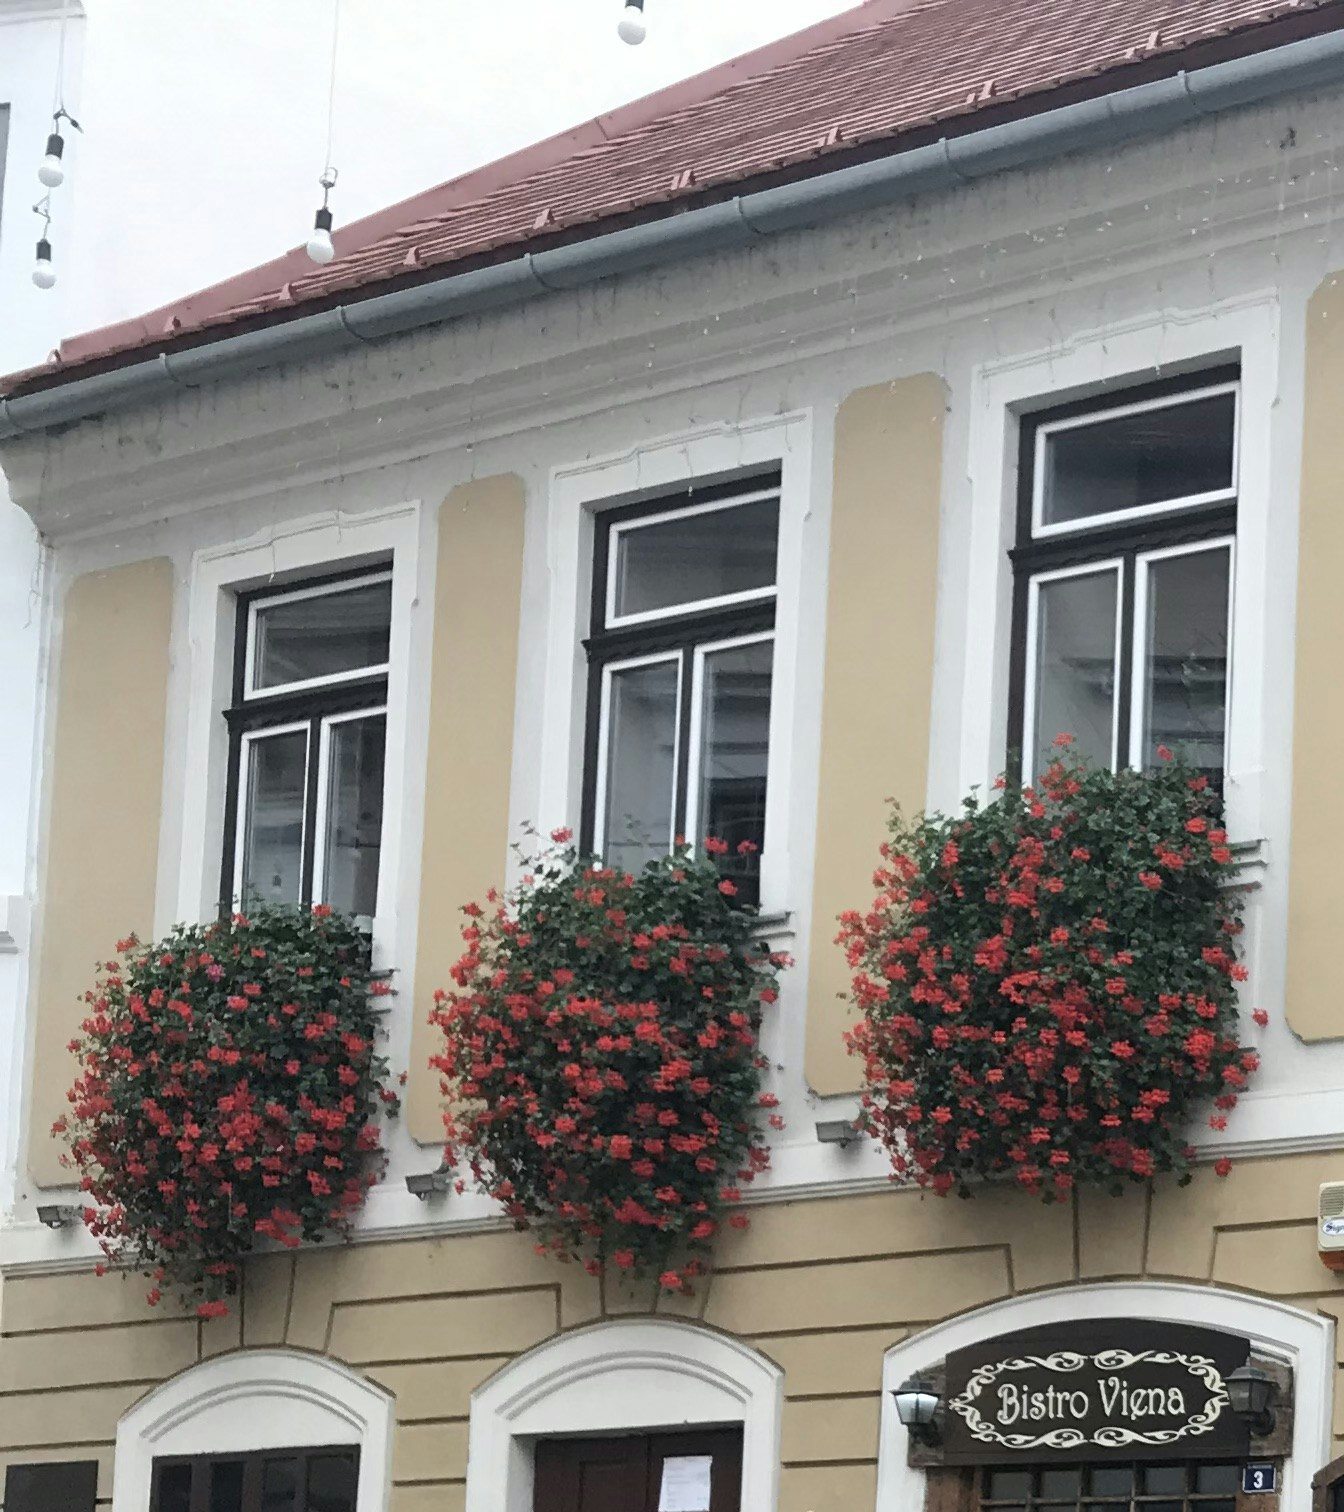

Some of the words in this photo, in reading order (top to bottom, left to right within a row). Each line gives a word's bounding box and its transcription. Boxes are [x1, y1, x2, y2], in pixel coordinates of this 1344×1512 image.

[997, 1383, 1089, 1425] Bistro
[1097, 1376, 1186, 1420] Viena
[1253, 1470, 1264, 1489] 3
